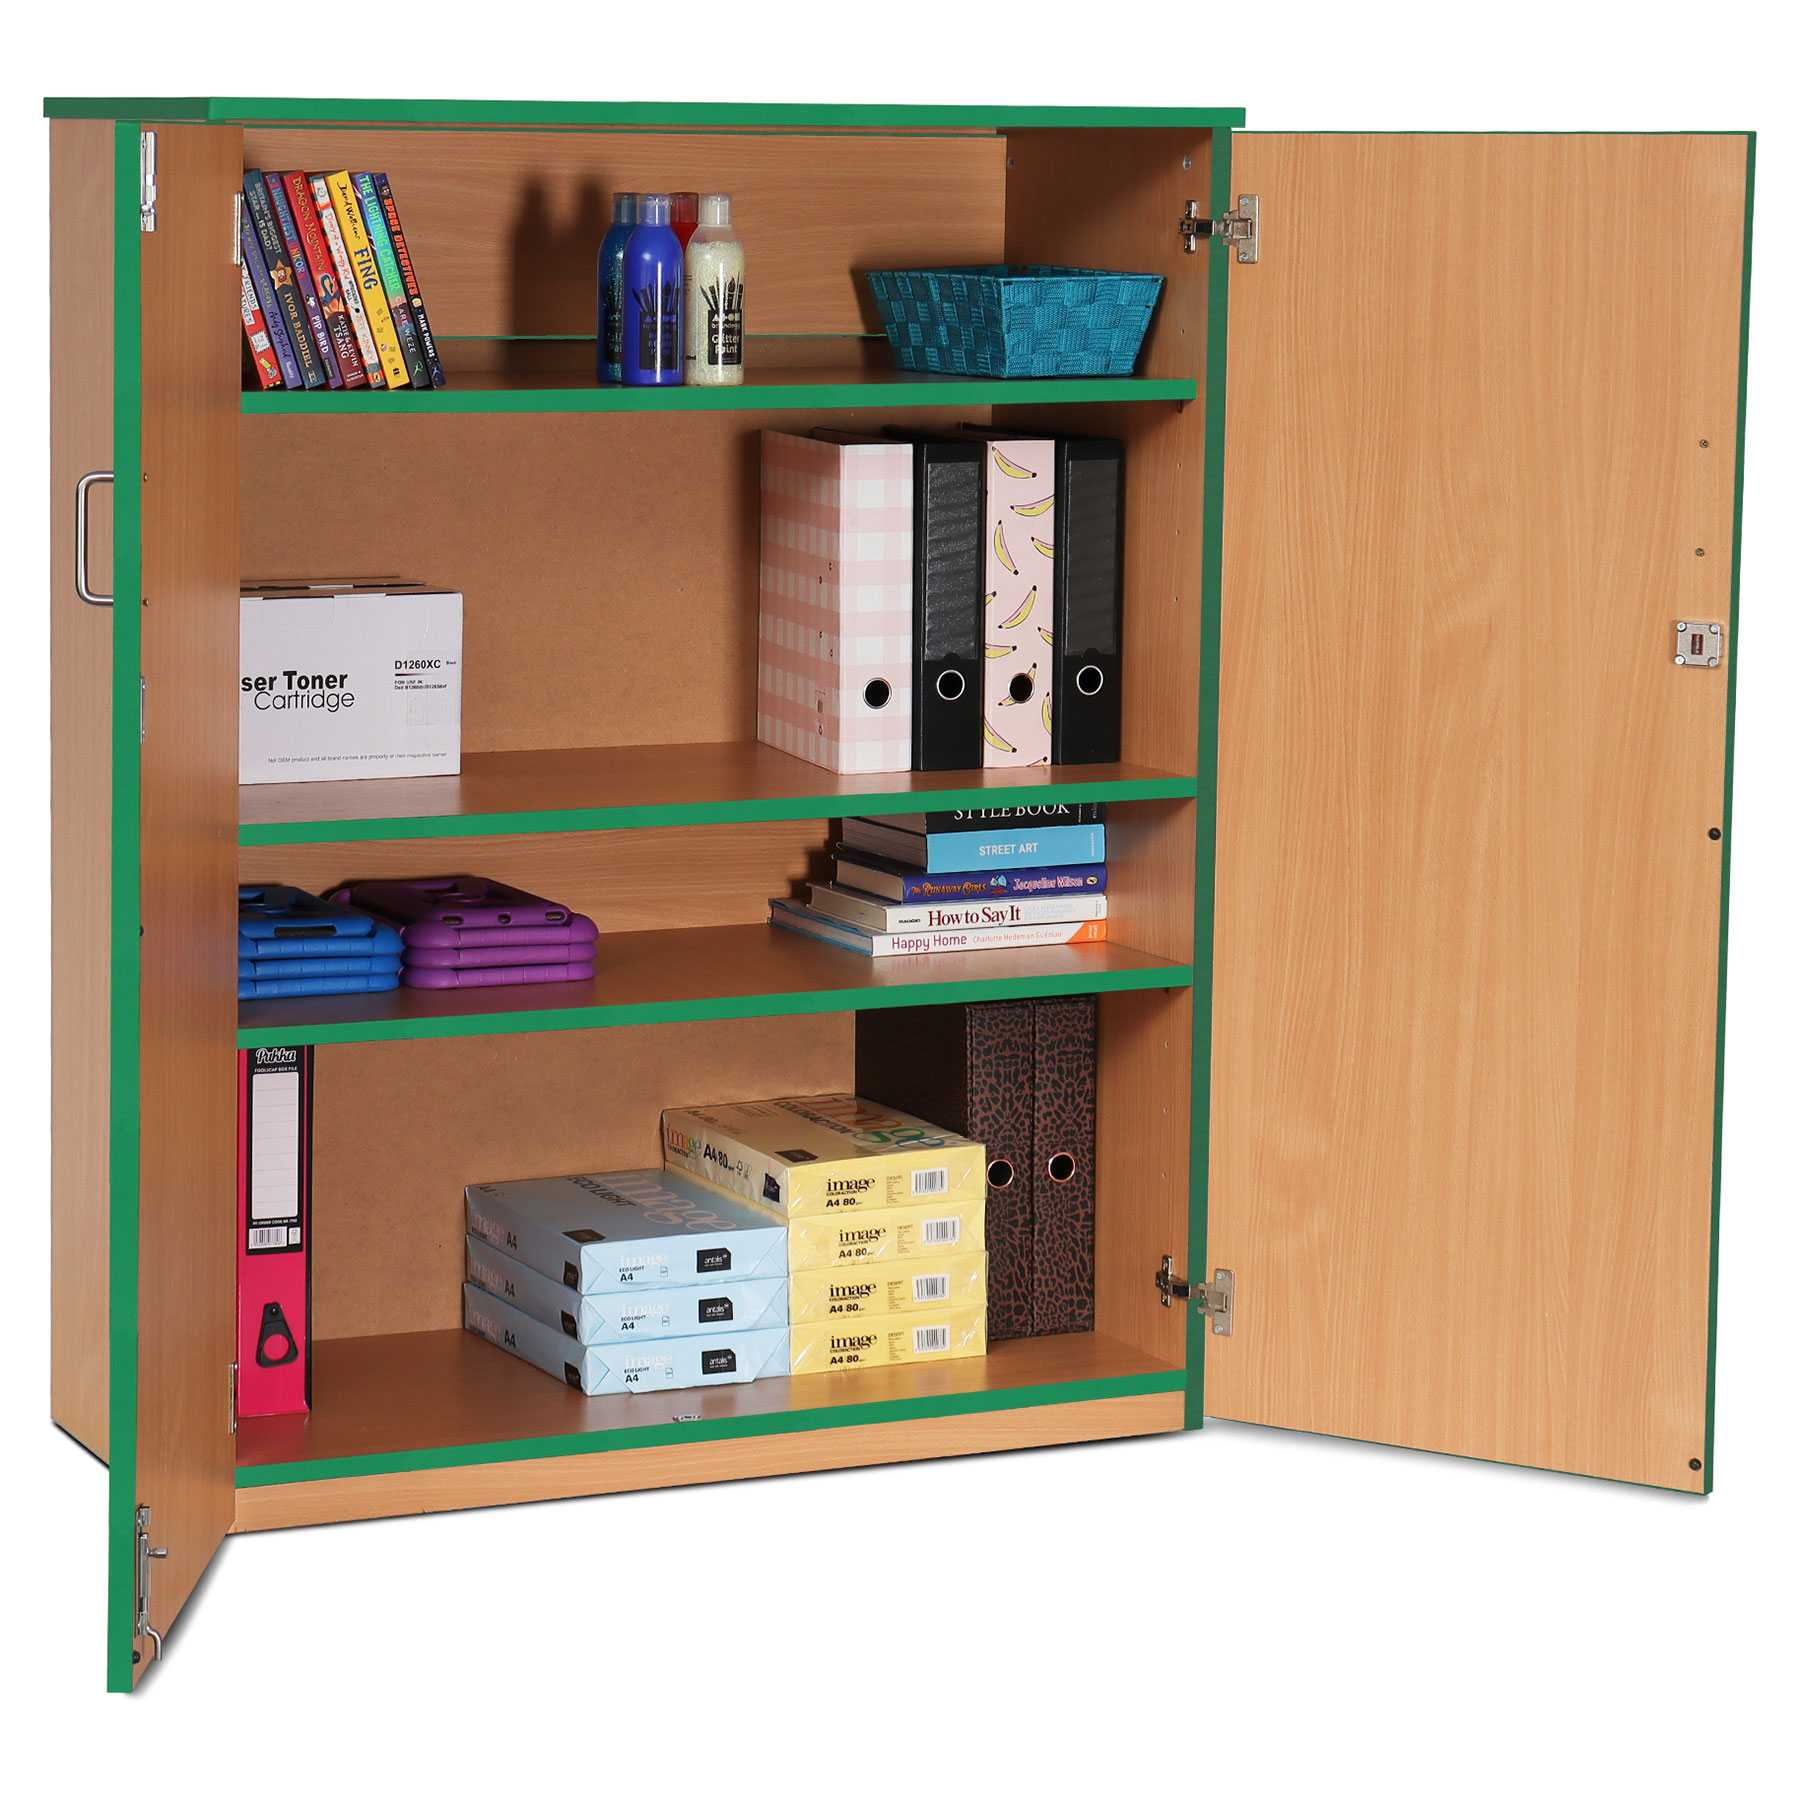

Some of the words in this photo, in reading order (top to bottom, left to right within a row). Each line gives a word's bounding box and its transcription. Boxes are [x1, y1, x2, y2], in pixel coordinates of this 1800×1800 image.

[360, 175, 373, 196] THE
[250, 190, 260, 211] STAR
[255, 183, 271, 220] BRITAIN'S
[267, 221, 282, 253] BIGGEST
[272, 187, 296, 240] NAUGHTIEST
[364, 196, 387, 247] LIGHTNING
[259, 220, 266, 228] IS
[292, 176, 310, 221] DRAGON
[305, 222, 327, 270] MOUNTAIN
[261, 230, 272, 250] DAD?
[384, 198, 400, 232] SPACE
[394, 234, 418, 296] DETECTIVES
[354, 248, 378, 290] FING
[380, 249, 400, 290] CATCHER
[244, 276, 258, 310] FRIENDS
[284, 292, 298, 320] IVOR
[293, 321, 312, 368] BADDIEL
[396, 297, 408, 326] CLARE
[405, 328, 416, 353] WEZE
[311, 315, 322, 329] PIP
[317, 332, 328, 354] BIRD
[333, 326, 349, 359] TSANG
[338, 314, 349, 336] KATIE
[347, 343, 359, 367] KEVIN
[418, 314, 428, 332] MARK
[423, 332, 435, 358] POWERS
[712, 334, 740, 344] Gitter
[395, 660, 441, 669] D1260XC
[241, 676, 277, 691] ser
[283, 670, 348, 690] Toner
[254, 690, 355, 712] Cartridge
[979, 844, 1016, 856] STREET
[1018, 842, 1038, 854] ART
[923, 882, 962, 896] RUNAWAY
[962, 882, 987, 895] GIRLS
[1013, 878, 1056, 892] Jacqueline
[1056, 876, 1083, 888] Wilson
[928, 910, 964, 927] How
[964, 910, 979, 924] to
[982, 907, 1008, 925] Say
[1009, 905, 1021, 921] It
[892, 937, 930, 952] Happy
[934, 934, 967, 946] Home
[973, 934, 1002, 943] Charlotte
[1004, 933, 1034, 941] Hedeman
[255, 1048, 297, 1064] Pukka
[666, 1124, 701, 1160] image
[704, 1144, 717, 1162] A4
[718, 1152, 728, 1168] 80
[827, 1178, 875, 1193] image
[589, 1189, 637, 1207] LIGHT
[592, 1172, 737, 1231] image
[843, 1198, 856, 1206] 80
[470, 1206, 504, 1245] image
[506, 1231, 517, 1250] A4
[840, 1228, 886, 1243] image
[621, 1254, 668, 1268] image
[704, 1256, 723, 1264] antalis
[839, 1250, 852, 1258] A4
[855, 1248, 867, 1256] 80
[620, 1273, 633, 1282] A4
[504, 1280, 515, 1298] A4
[830, 1283, 876, 1299] image
[621, 1303, 669, 1317] image
[706, 1305, 724, 1313] antalis
[829, 1305, 843, 1314] A4
[846, 1304, 858, 1312] 80
[621, 1322, 635, 1330] A4
[504, 1329, 516, 1348] A4
[831, 1334, 877, 1350] image
[625, 1354, 672, 1369] image
[709, 1357, 727, 1365] antalis
[830, 1357, 843, 1365] A4
[846, 1355, 859, 1363] 80
[625, 1374, 639, 1383] A4
